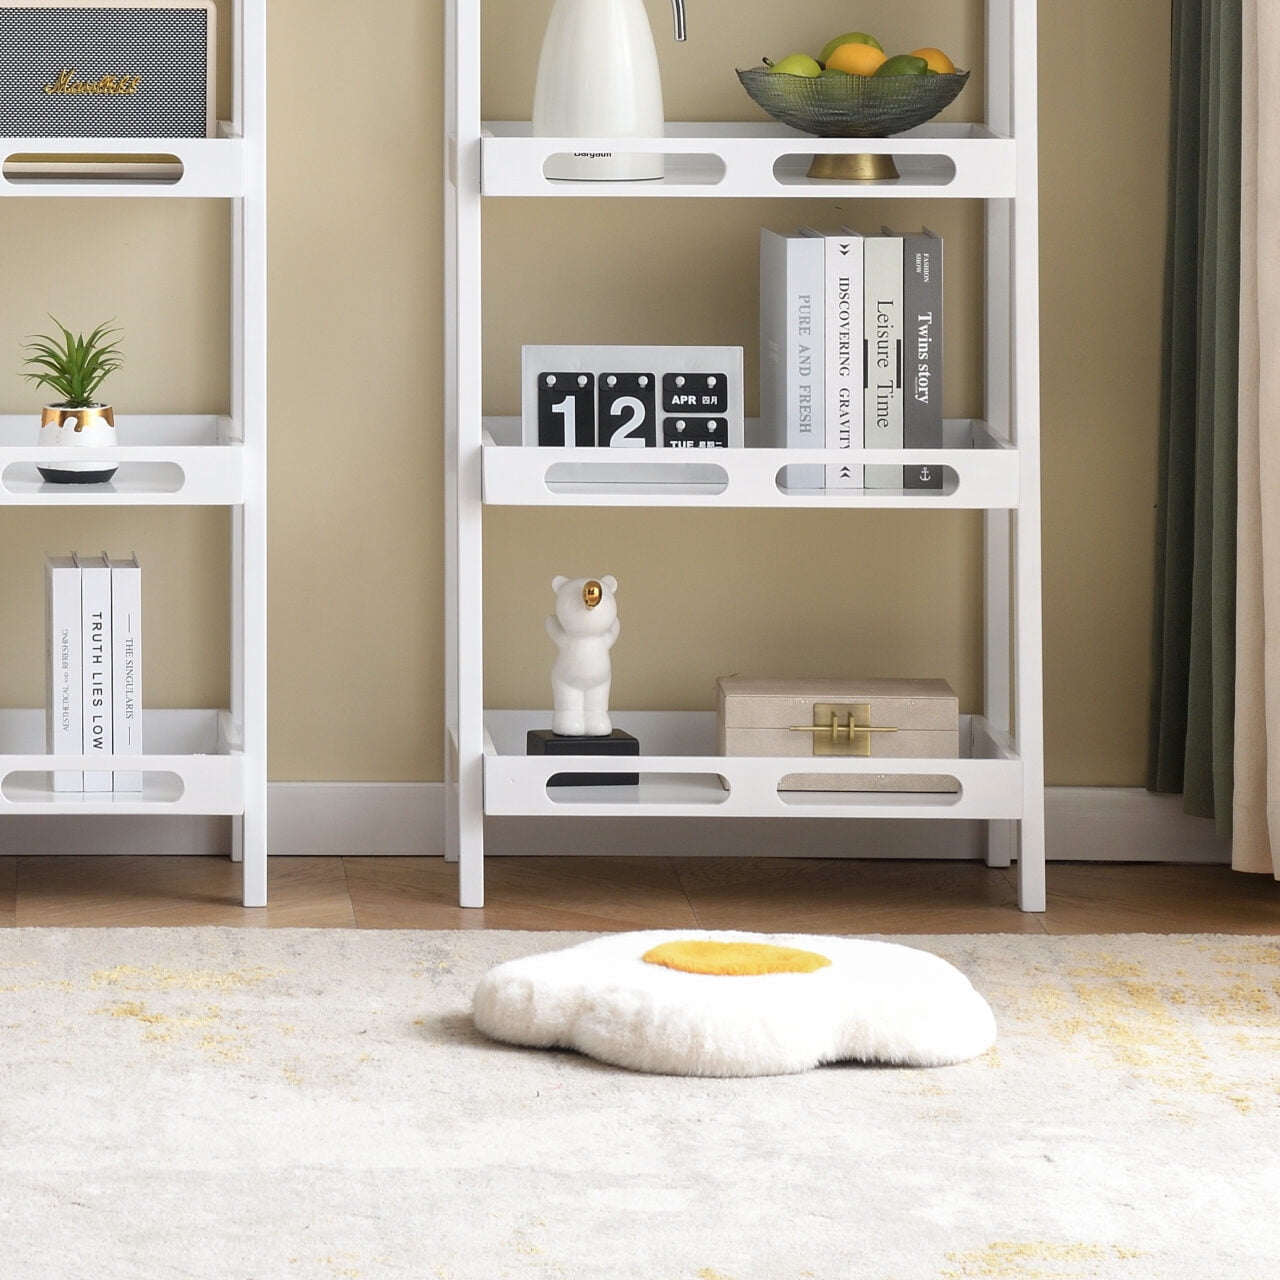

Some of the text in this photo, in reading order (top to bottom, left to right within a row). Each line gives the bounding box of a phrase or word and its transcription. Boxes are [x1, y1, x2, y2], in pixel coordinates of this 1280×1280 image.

[922, 253, 930, 283] FASHION
[671, 394, 697, 405] APR
[701, 395, 718, 405] 四月
[798, 294, 812, 434] PURE AND FRESH
[876, 299, 894, 428] Leisure Time
[914, 311, 933, 404] Twins story
[91, 611, 104, 750] TRUTH LIES LOW
[125, 637, 134, 720] THE SINGULARIS
